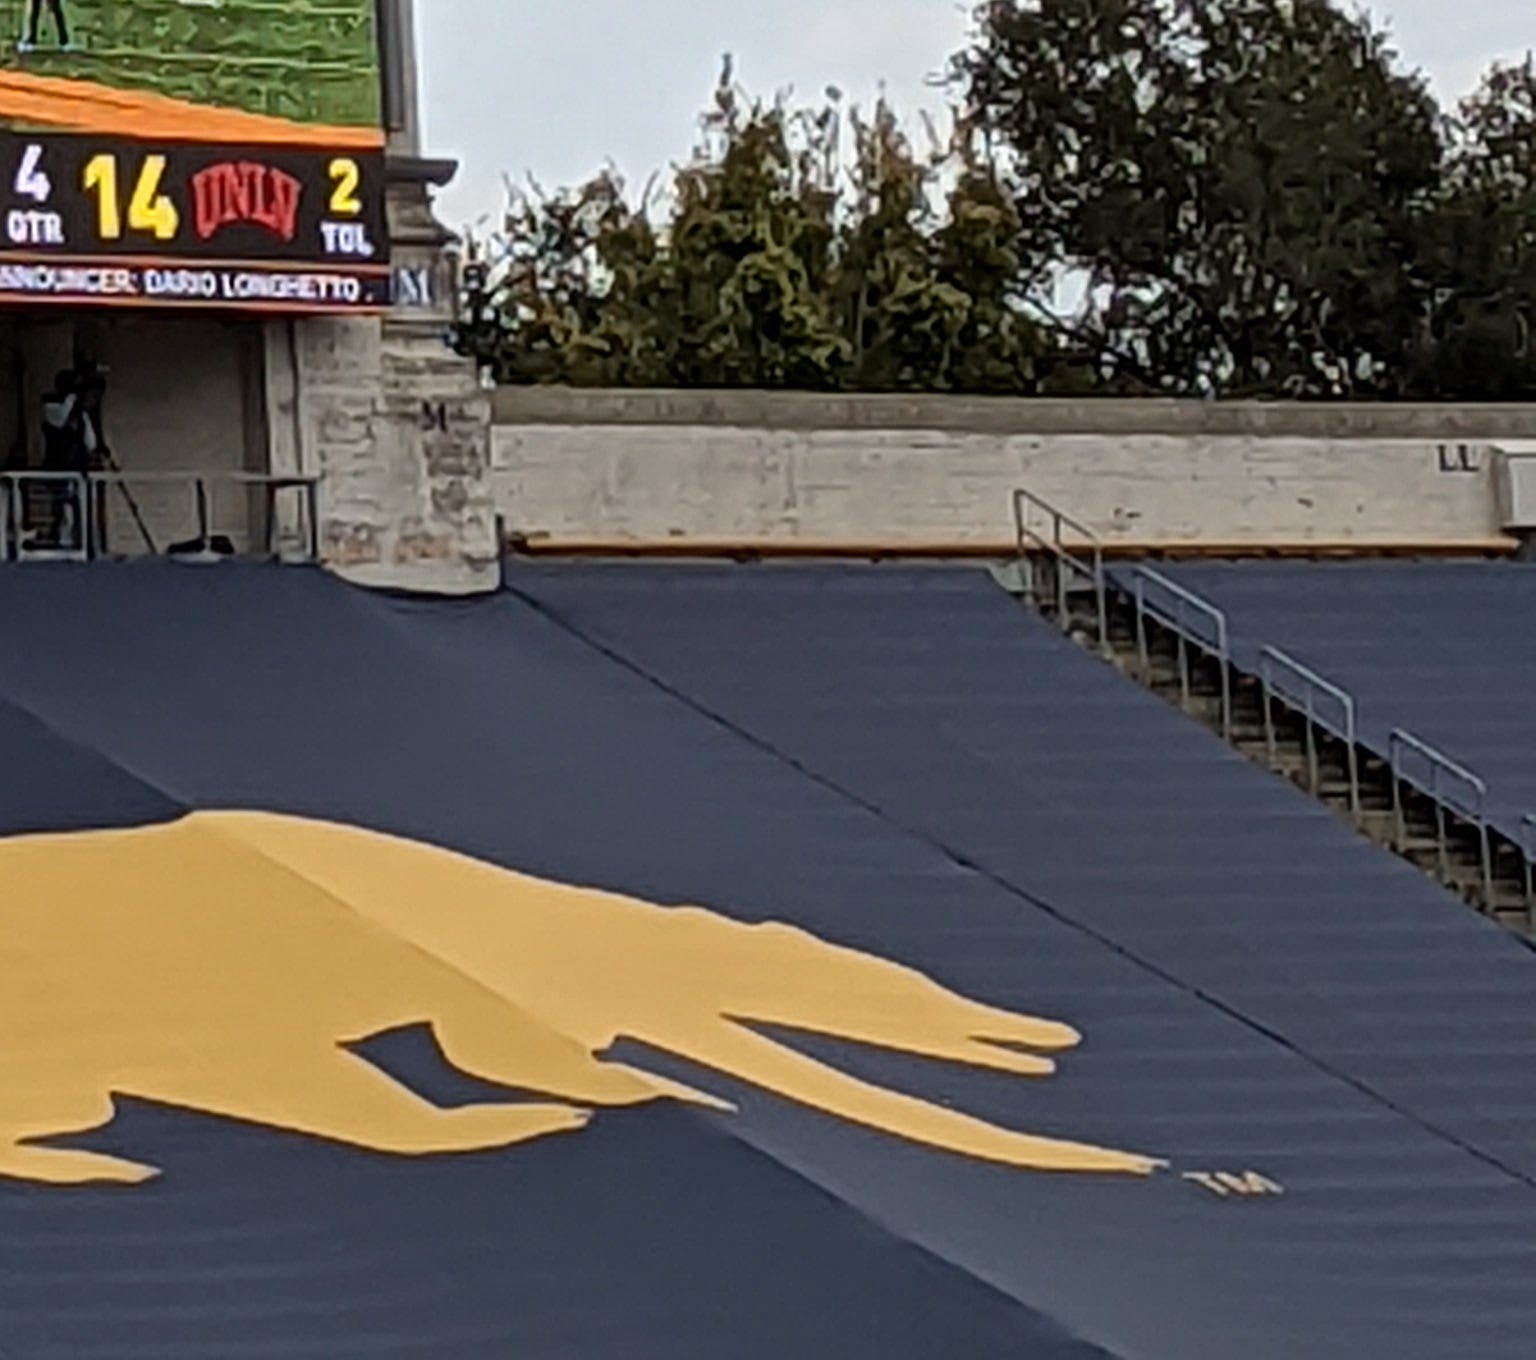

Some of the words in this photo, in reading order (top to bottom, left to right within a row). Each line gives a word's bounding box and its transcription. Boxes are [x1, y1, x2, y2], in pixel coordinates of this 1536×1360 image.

[15, 144, 51, 202] 4
[83, 154, 178, 240] 14
[192, 160, 301, 242] UNLV
[328, 158, 362, 214] 2
[320, 222, 374, 256] TOL
